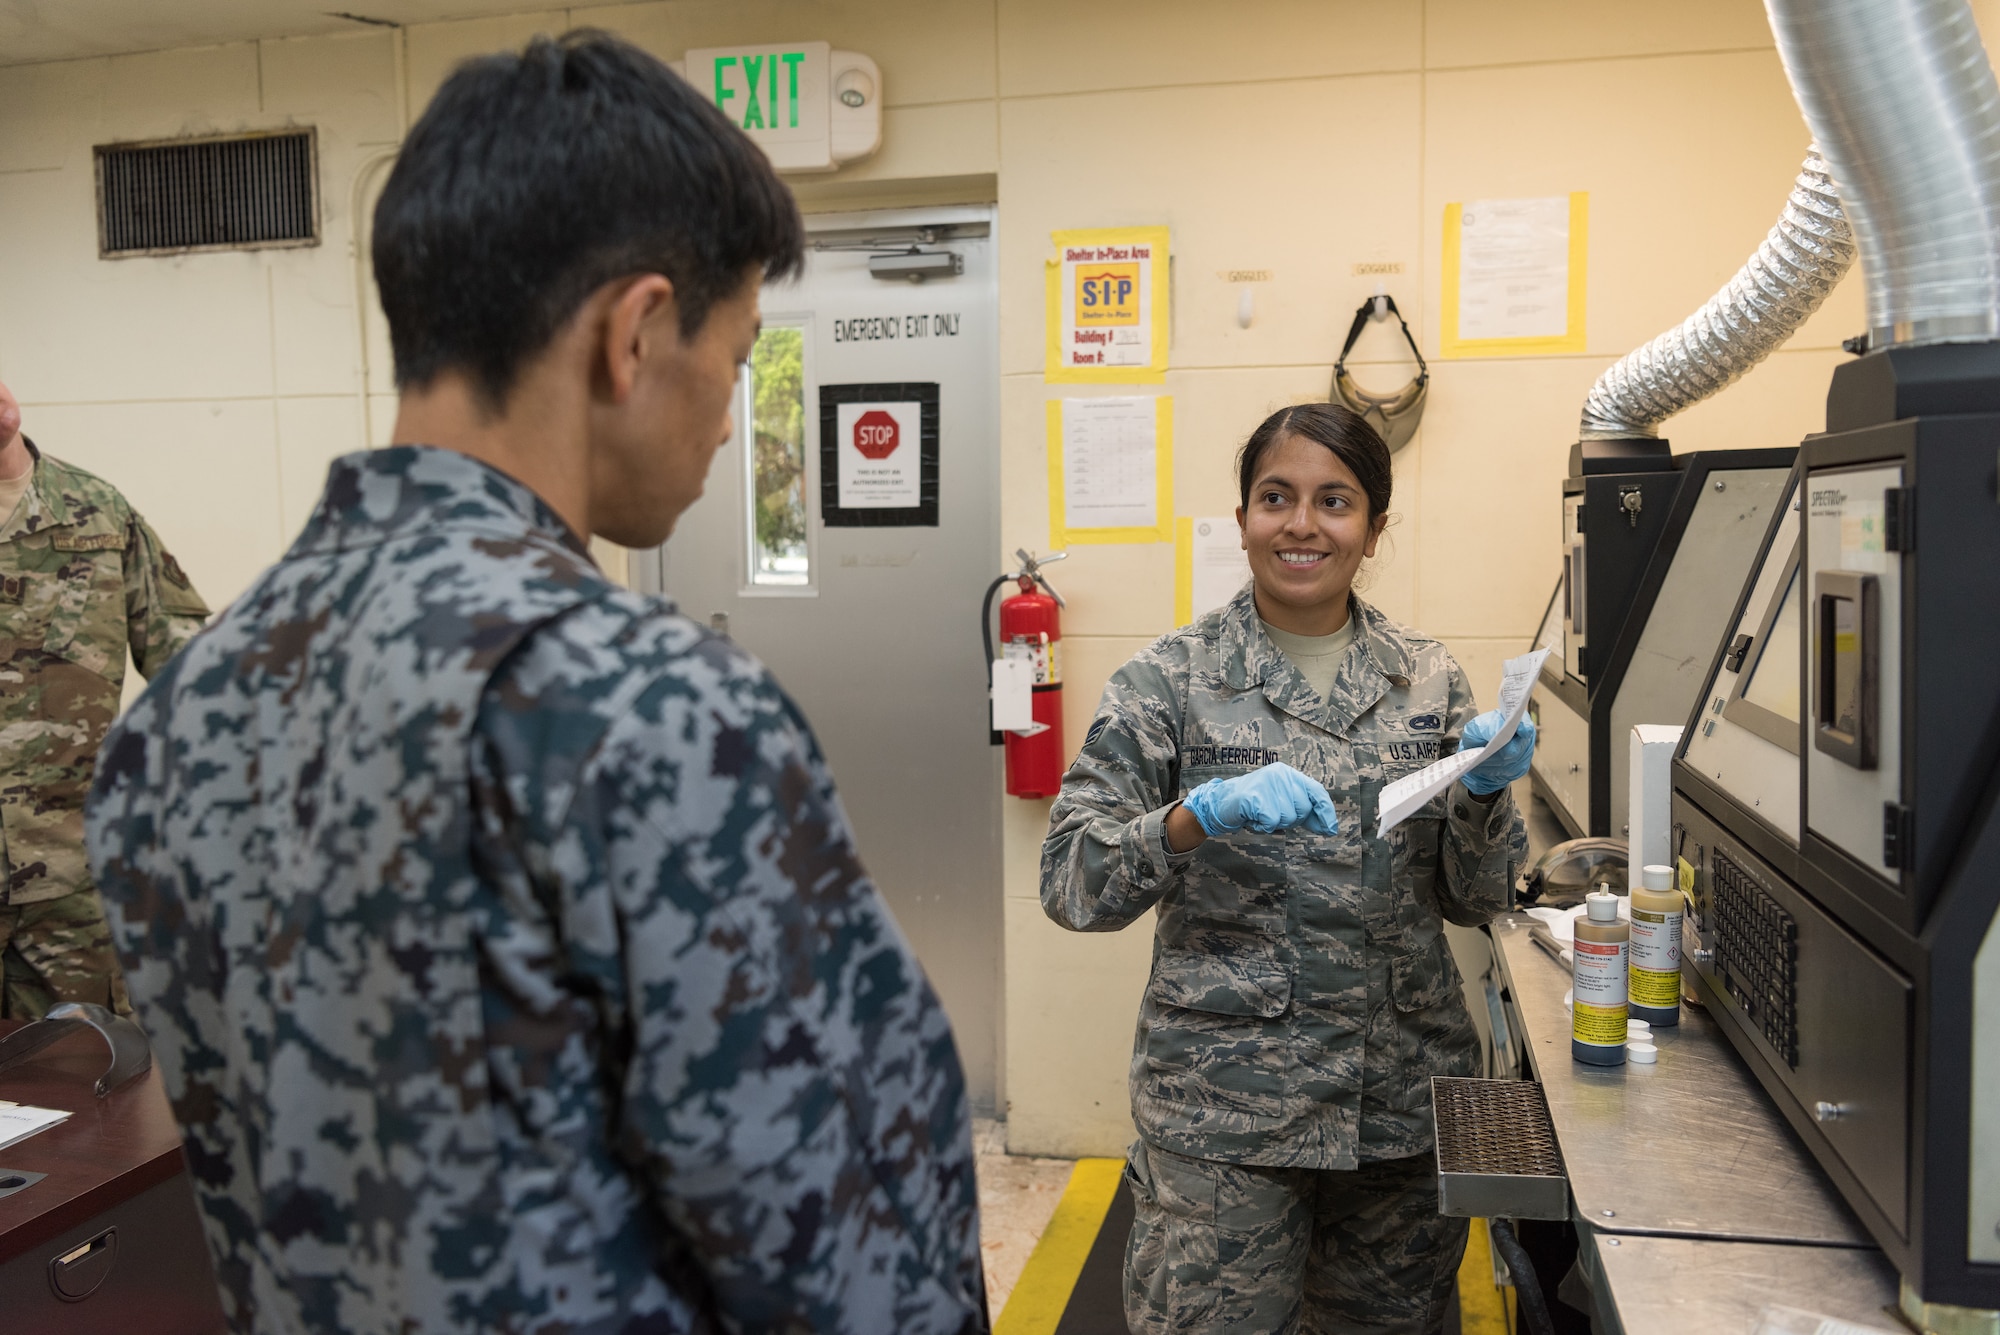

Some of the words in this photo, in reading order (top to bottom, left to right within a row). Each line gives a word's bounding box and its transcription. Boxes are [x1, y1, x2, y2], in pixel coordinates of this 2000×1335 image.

[714, 52, 805, 130] EXIT
[1066, 249, 1095, 261] Shelter
[1131, 246, 1150, 259] Area
[1357, 263, 1401, 275] GOGGLES
[834, 316, 901, 343] EMERGENCY
[906, 315, 929, 338] EXIT
[934, 313, 961, 336] ONLY
[1075, 330, 1106, 346] Building
[1073, 351, 1095, 364] Room
[859, 424, 894, 446] STOP
[1190, 746, 1217, 766] GARCIA
[1220, 746, 1279, 766] FERRUFINO
[1388, 744, 1416, 761] U.S.
